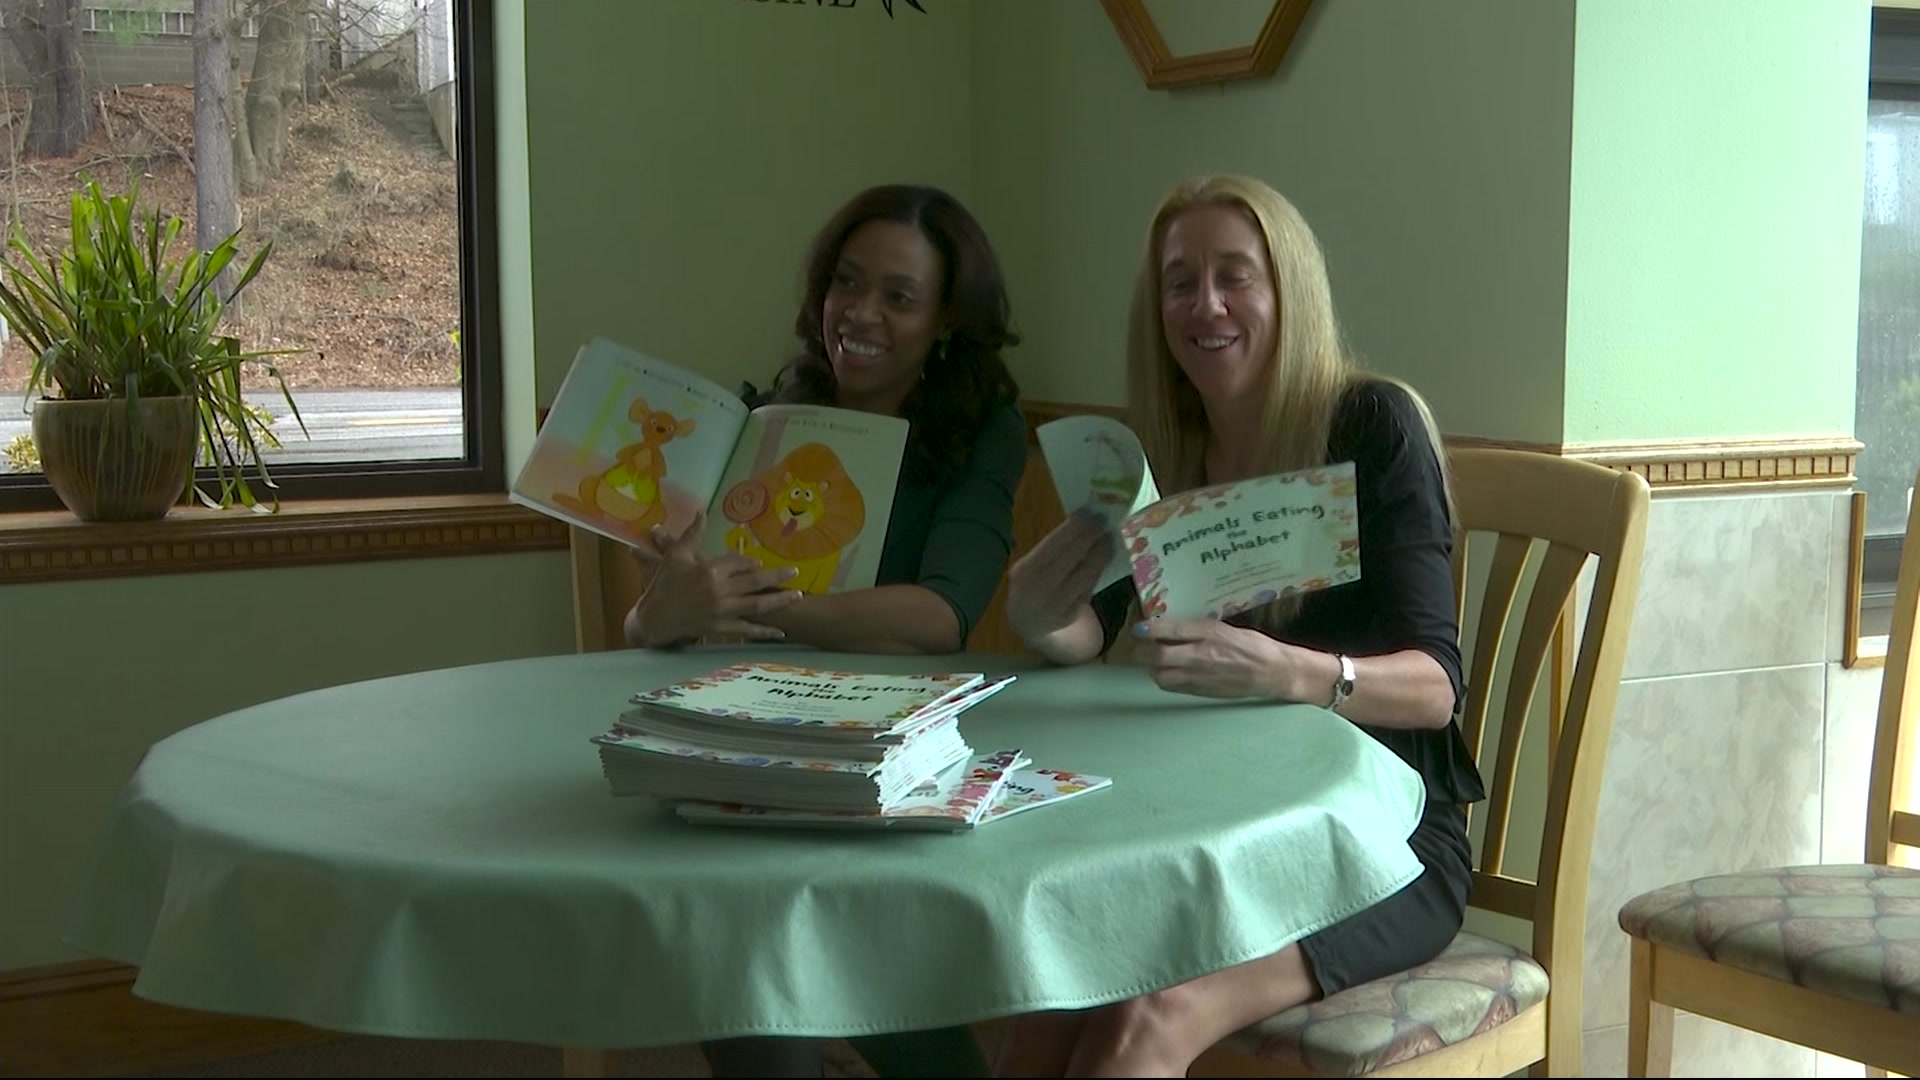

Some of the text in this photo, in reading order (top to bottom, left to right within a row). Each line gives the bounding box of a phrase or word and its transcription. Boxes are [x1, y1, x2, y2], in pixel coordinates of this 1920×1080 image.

[1162, 505, 1325, 556] Animals Eating
[1200, 529, 1290, 564] Alphabet
[747, 675, 926, 694] Animals Eating
[767, 688, 872, 702] Alphabet
